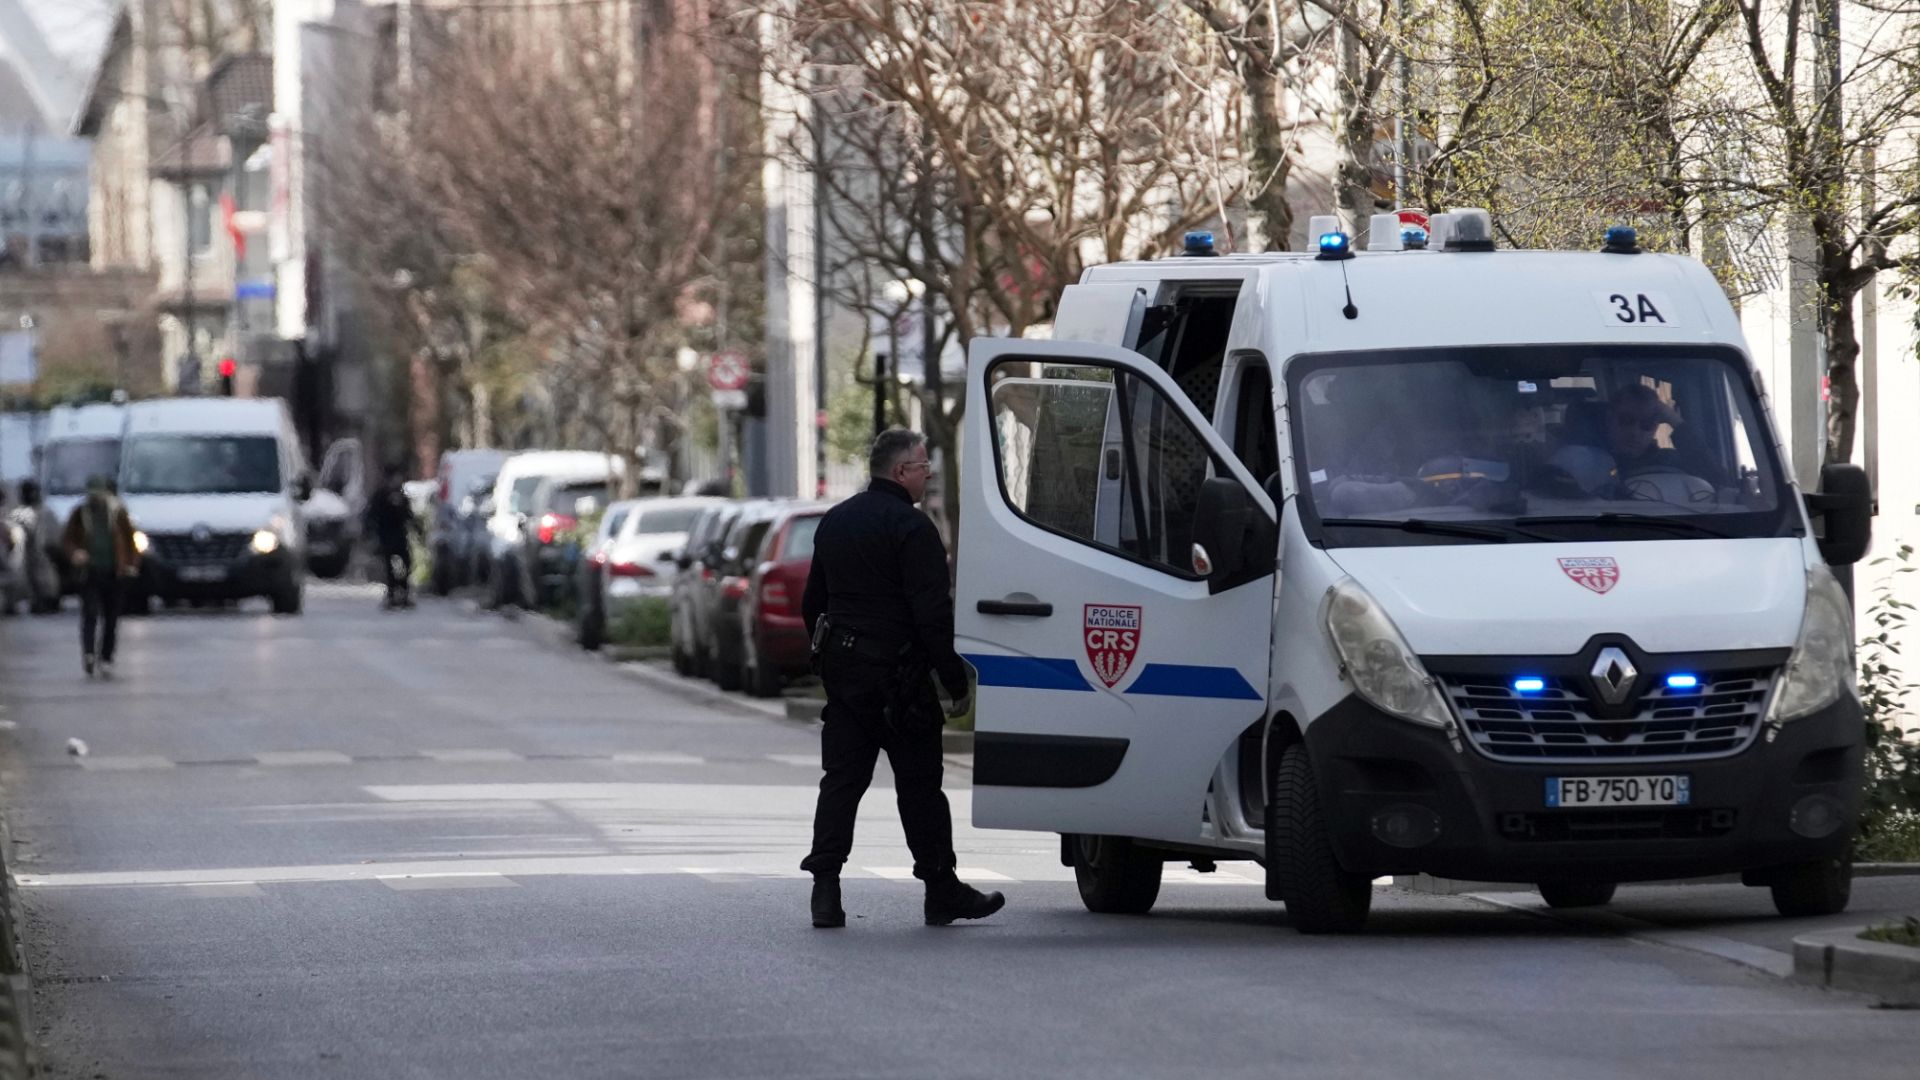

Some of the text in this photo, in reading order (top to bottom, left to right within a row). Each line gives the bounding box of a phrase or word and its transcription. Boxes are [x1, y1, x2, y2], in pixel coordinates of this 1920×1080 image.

[1610, 294, 1666, 323] 3A
[1568, 568, 1616, 577] CRS
[1092, 608, 1134, 618] POLICE
[1087, 618, 1137, 628] NATIONALE
[1087, 629, 1136, 651] CRS
[1561, 778, 1675, 803] FB-750-YQ
